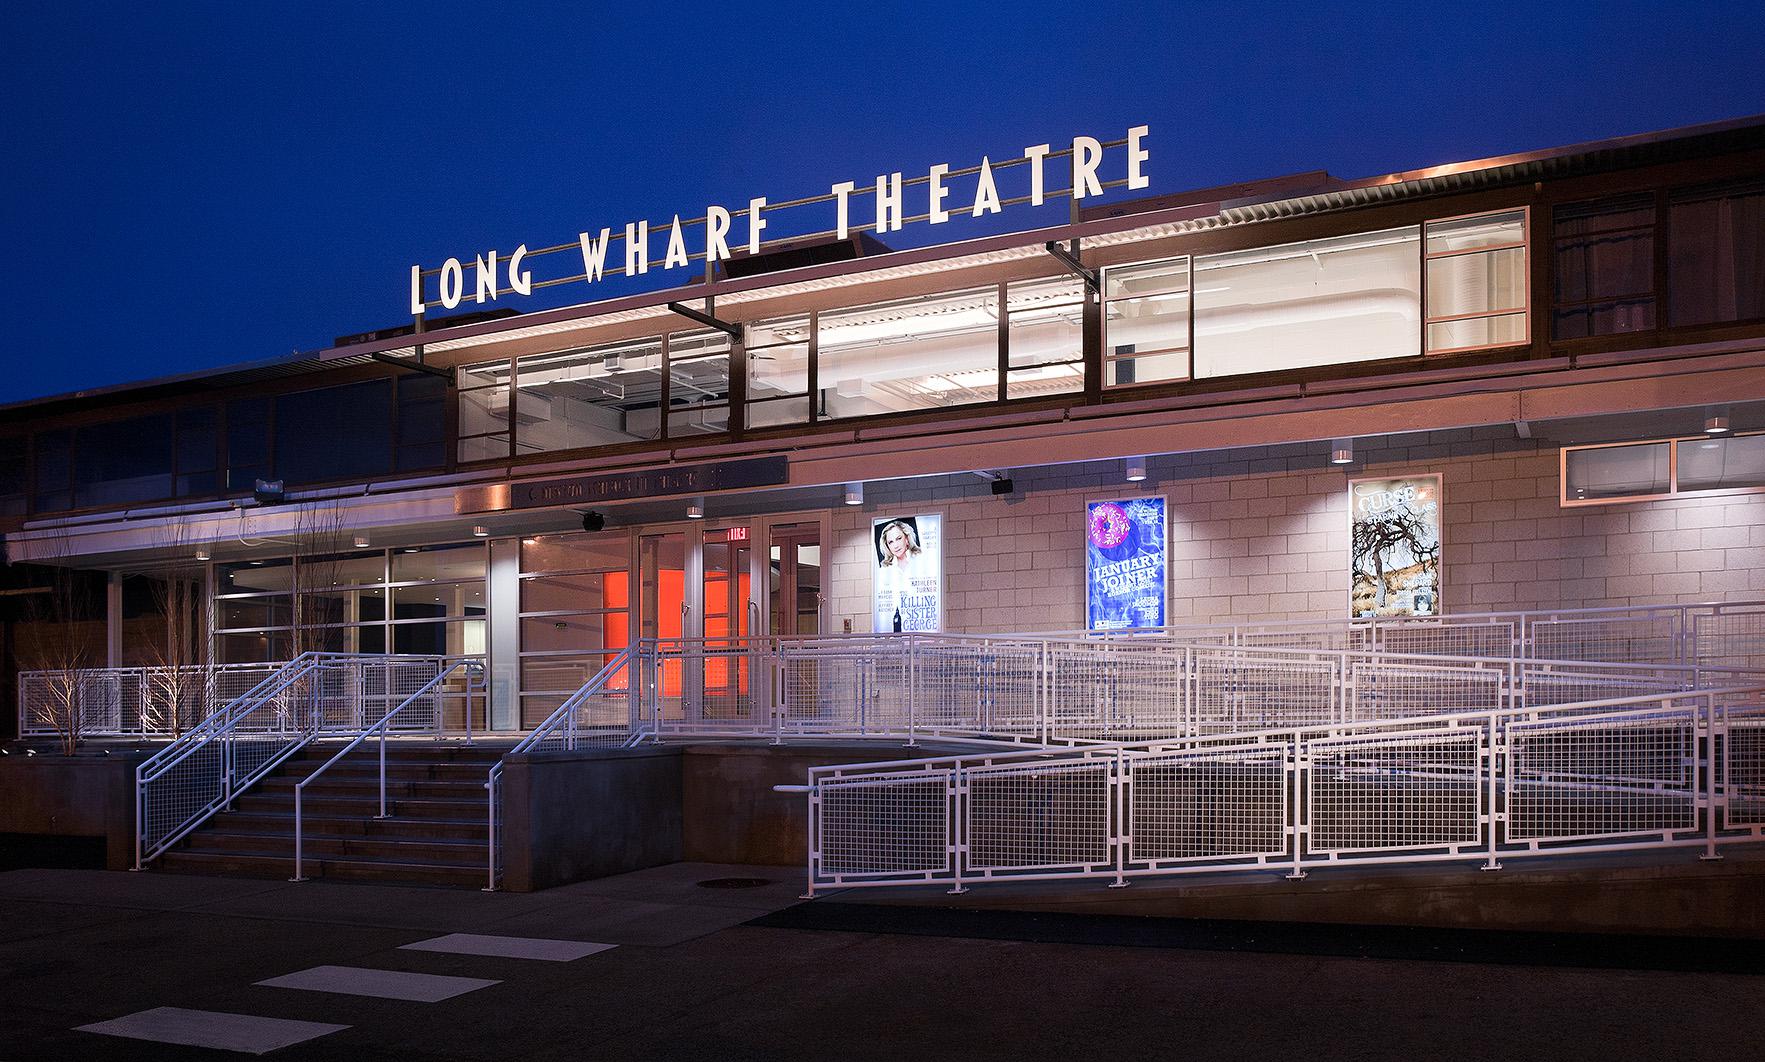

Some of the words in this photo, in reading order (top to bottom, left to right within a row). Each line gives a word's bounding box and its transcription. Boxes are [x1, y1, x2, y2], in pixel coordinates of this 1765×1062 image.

[411, 243, 532, 315] LONG
[579, 196, 768, 284] WHARF
[831, 125, 1150, 240] THEATRE
[1358, 486, 1416, 512] CURSE
[1093, 552, 1161, 583] JANUARY
[1101, 566, 1159, 594] JOINER
[900, 595, 937, 609] KILLING
[905, 607, 937, 619] SISTER
[903, 618, 938, 631] GEORGE
